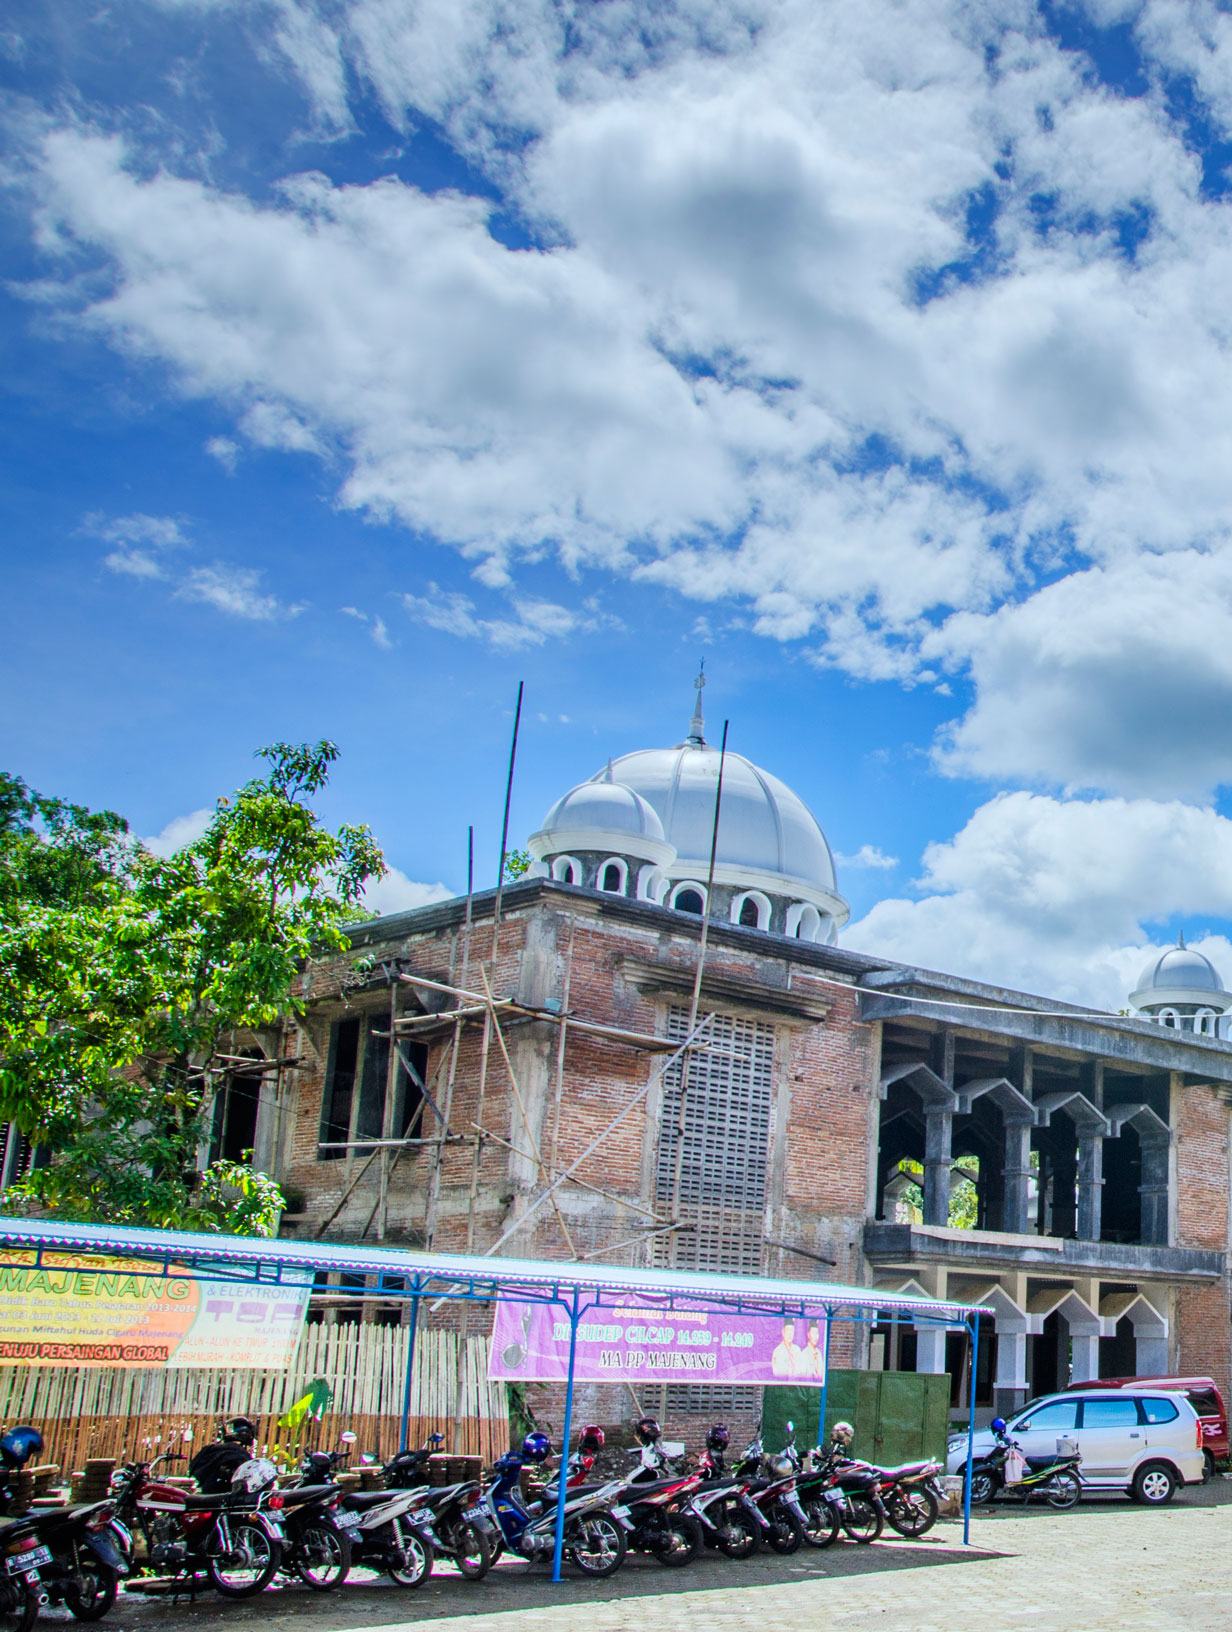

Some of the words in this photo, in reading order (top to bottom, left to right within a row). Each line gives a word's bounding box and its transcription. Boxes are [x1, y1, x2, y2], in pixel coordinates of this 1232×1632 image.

[0, 1268, 191, 1300] MAJENANG
[220, 1285, 304, 1300] ELEKTRONIK
[206, 1300, 303, 1324] TOP
[625, 1325, 675, 1345] CILCAP
[39, 1343, 121, 1360] PERSAINGAN
[122, 1345, 168, 1361] GLOBAL
[600, 1350, 623, 1368] MA
[625, 1351, 645, 1369] PP
[646, 1351, 717, 1370] MAJENANG
